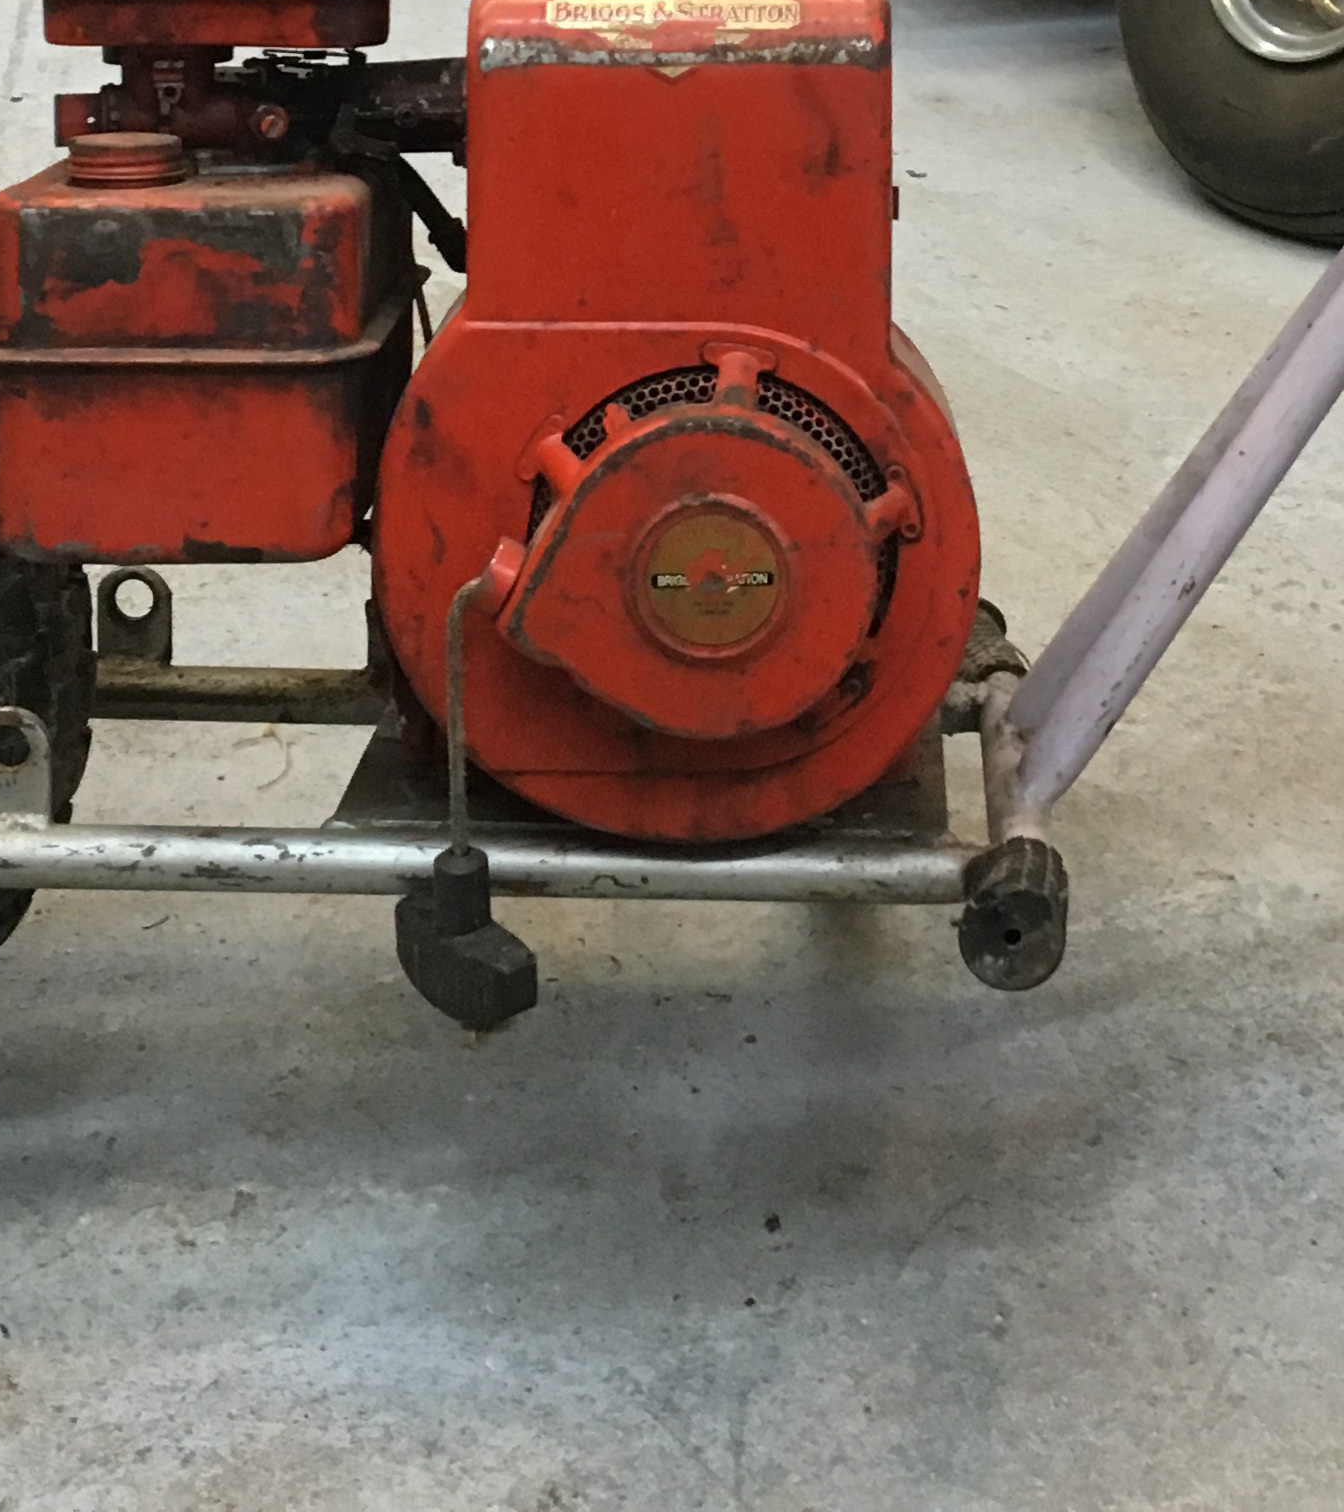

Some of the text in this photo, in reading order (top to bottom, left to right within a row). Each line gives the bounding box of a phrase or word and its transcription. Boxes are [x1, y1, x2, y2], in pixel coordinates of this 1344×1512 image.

[555, 0, 799, 23] BRIGGS & STRATTON
